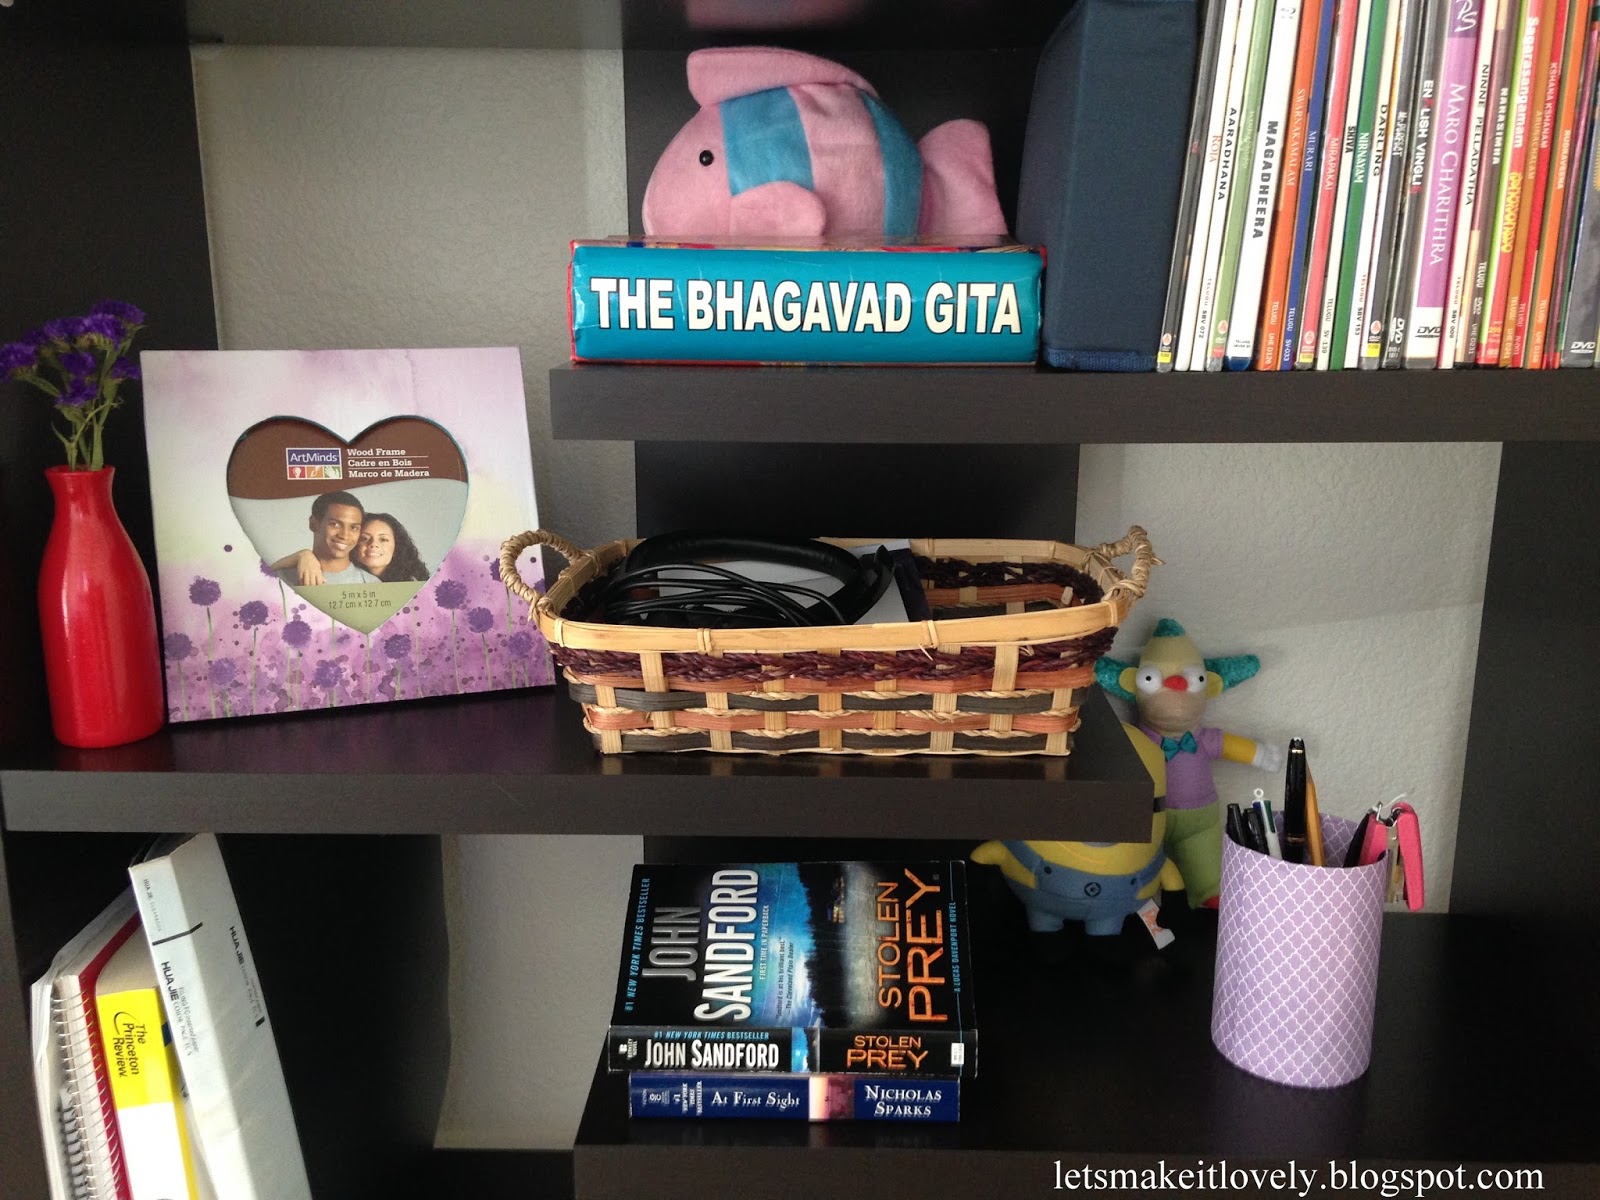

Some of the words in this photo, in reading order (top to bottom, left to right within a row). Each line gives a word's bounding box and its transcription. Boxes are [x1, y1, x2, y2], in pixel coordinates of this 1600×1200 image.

[1477, 64, 1489, 107] NINNE
[1442, 83, 1467, 144] MARO
[1492, 87, 1508, 165] NARASIMHA
[1209, 135, 1222, 163] ROJA
[1217, 107, 1237, 200] AARADHANA
[1305, 130, 1317, 172] MURARI
[1345, 126, 1357, 154] SHIVA
[1372, 104, 1388, 177] DARLING
[1325, 137, 1340, 190] MIRAPAKAI
[1353, 132, 1370, 183] NIRNAYAM
[1465, 116, 1483, 206] PELLADATHA
[1252, 120, 1279, 239] MAGADHEERA
[1429, 153, 1459, 266] CHARITHRA
[1476, 261, 1487, 289] TELUGU
[589, 277, 675, 329] THE
[687, 278, 912, 333] BHAGAVAD
[925, 282, 1022, 334] GITA
[1270, 301, 1280, 325] TELUGU
[1325, 298, 1333, 322] TELUGU
[1287, 307, 1296, 332] TELUGU
[1394, 317, 1405, 344] DVD
[1417, 326, 1442, 335] DVD
[1571, 342, 1595, 350] DVD
[290, 452, 338, 463] ArtMinds
[347, 448, 374, 456] Wood
[376, 448, 406, 456] Frame
[347, 459, 376, 467] Cadre
[392, 458, 412, 466] Bois
[348, 470, 379, 478] Marco
[395, 469, 430, 477] Madera
[342, 591, 347, 599] 5
[636, 877, 650, 924] BESTSELLER
[949, 901, 957, 922] NOVEL
[762, 904, 770, 938] PAPERBACK
[229, 925, 241, 949] HUA
[236, 949, 245, 965] JIE
[633, 926, 644, 952] TIMES
[642, 905, 701, 981] JOHN
[694, 868, 761, 1022] SANDFORD
[877, 881, 902, 1009] STOLEN
[904, 867, 948, 1022] PREY
[950, 925, 960, 962] DAVENPORT
[160, 960, 175, 985] HUA
[629, 954, 640, 978] YORK
[759, 963, 767, 980] FIRST
[952, 965, 961, 986] LUCAS
[167, 984, 180, 1002] JIE
[627, 979, 637, 1000] NEW
[136, 1024, 147, 1044] The
[727, 1032, 769, 1040] BESTSELLER
[854, 1035, 922, 1049] STOLEN
[123, 1023, 139, 1075] Princeton
[644, 1039, 686, 1068] JOHN
[691, 1039, 779, 1068] SANDFORD
[846, 1048, 928, 1070] PREY
[711, 1091, 729, 1106] At
[732, 1091, 762, 1106] First
[766, 1091, 801, 1110] Sight
[865, 1085, 942, 1103] NICHOLAS
[874, 1101, 932, 1117] SPARKS
